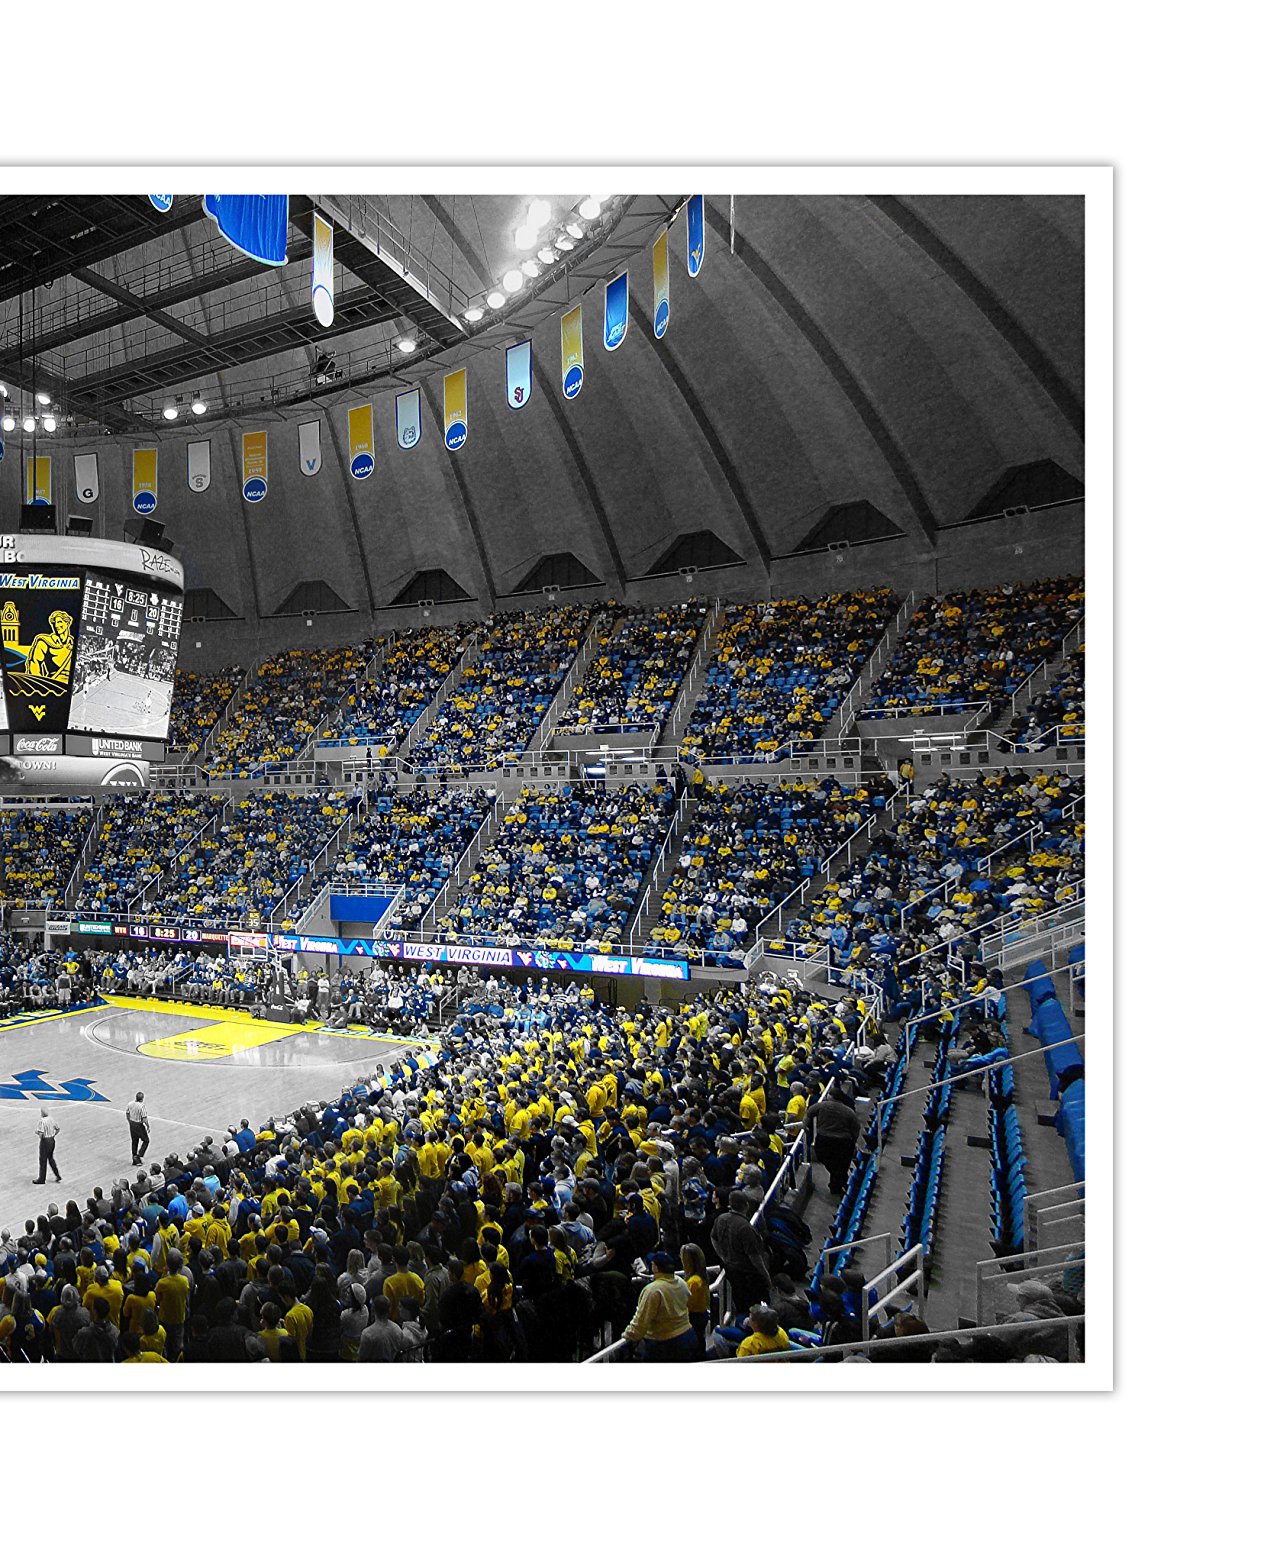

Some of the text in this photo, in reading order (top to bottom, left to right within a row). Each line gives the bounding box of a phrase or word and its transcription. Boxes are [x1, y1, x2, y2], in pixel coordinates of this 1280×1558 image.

[566, 379, 583, 395] NCAA
[448, 434, 467, 446] NCAA
[354, 465, 373, 475] NCAA
[195, 478, 204, 488] S
[82, 488, 94, 499] G
[29, 574, 80, 589] VIRGINIA
[128, 591, 145, 605] 8:25
[113, 600, 122, 610] 16
[148, 607, 157, 618] 20
[99, 739, 142, 752] UNITED BANK
[248, 918, 259, 927] 35
[133, 927, 145, 935] 16
[154, 927, 176, 938] 8:25
[185, 930, 198, 940] 20
[404, 945, 510, 963] WEST VIRGINIA
[591, 954, 628, 974] WEST
